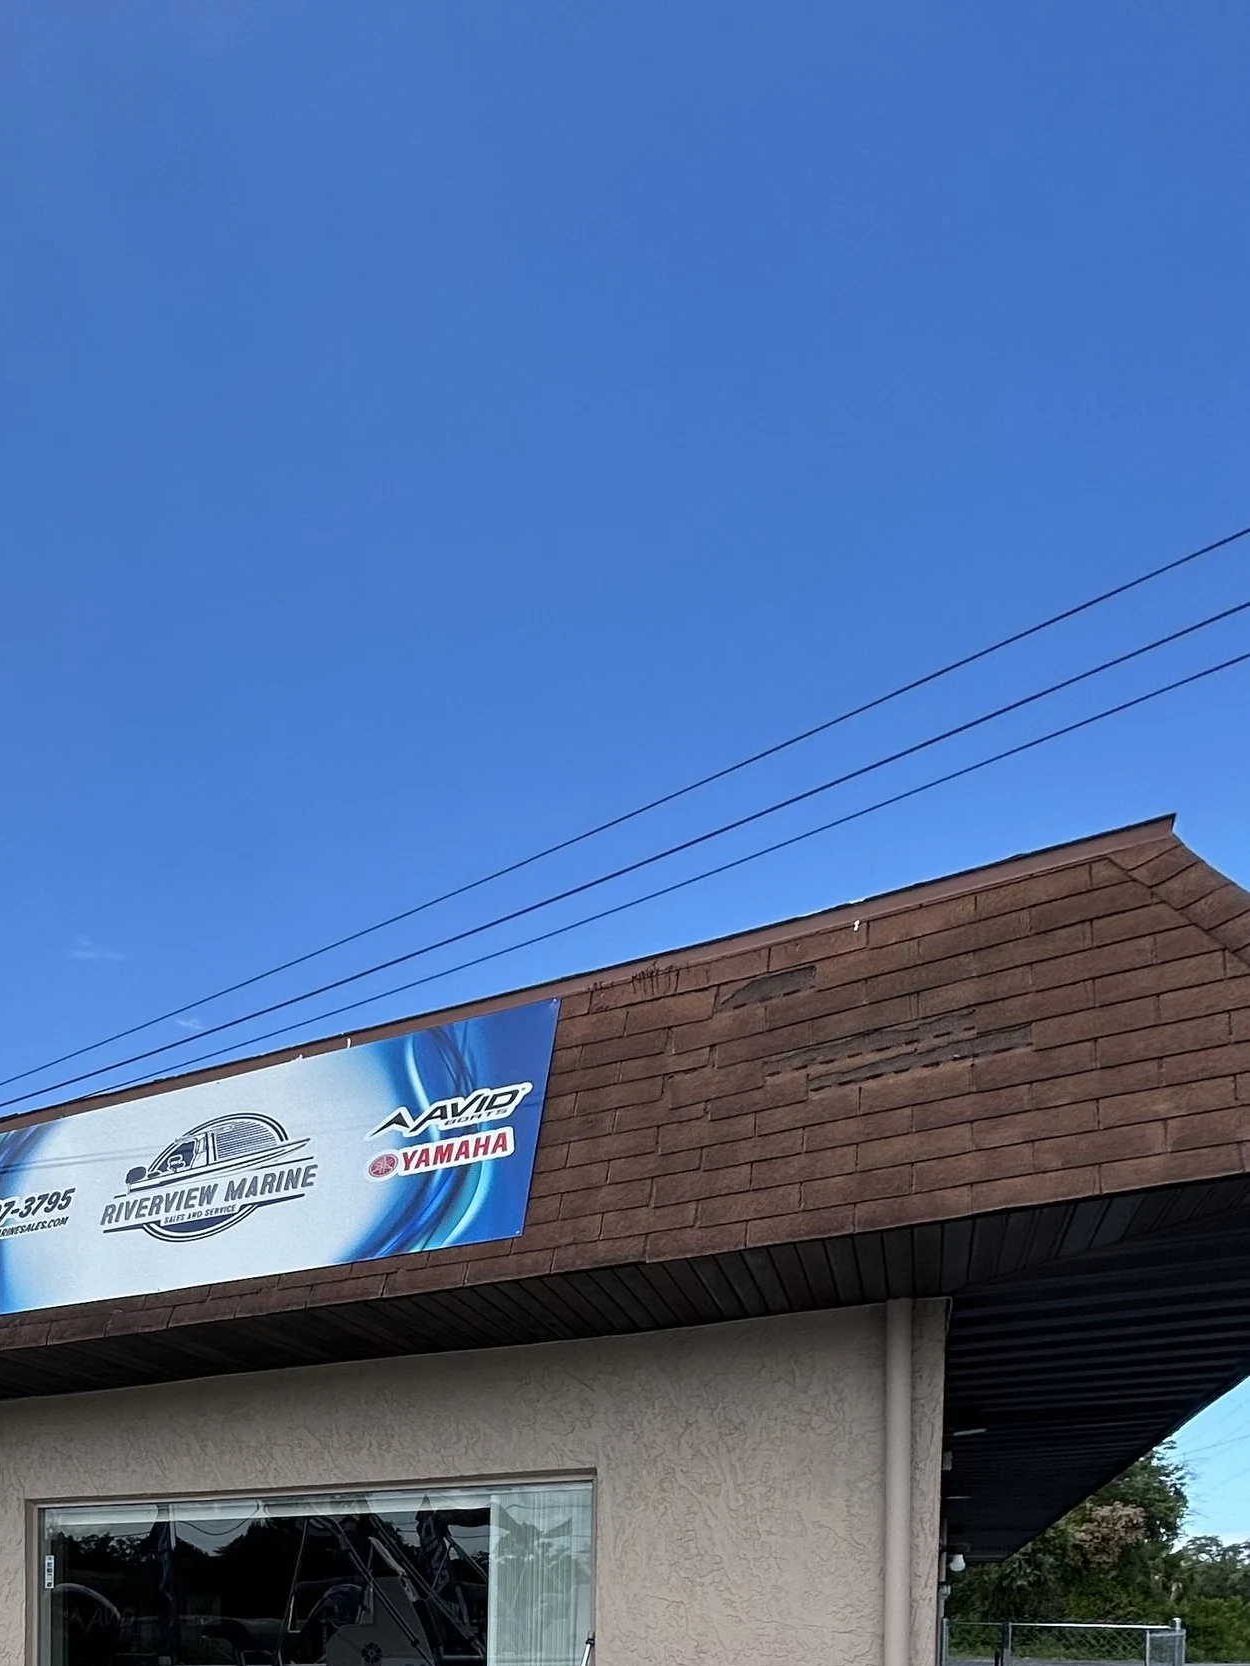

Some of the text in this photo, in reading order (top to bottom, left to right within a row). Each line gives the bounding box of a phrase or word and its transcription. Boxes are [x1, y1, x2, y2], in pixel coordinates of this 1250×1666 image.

[408, 1089, 520, 1133] AVID
[444, 1108, 508, 1126] BOATS
[402, 1131, 508, 1172] YAMAHA
[100, 1164, 319, 1225] RIVERVIEW MARINE
[164, 1203, 237, 1224] SALES AND SERVICE
